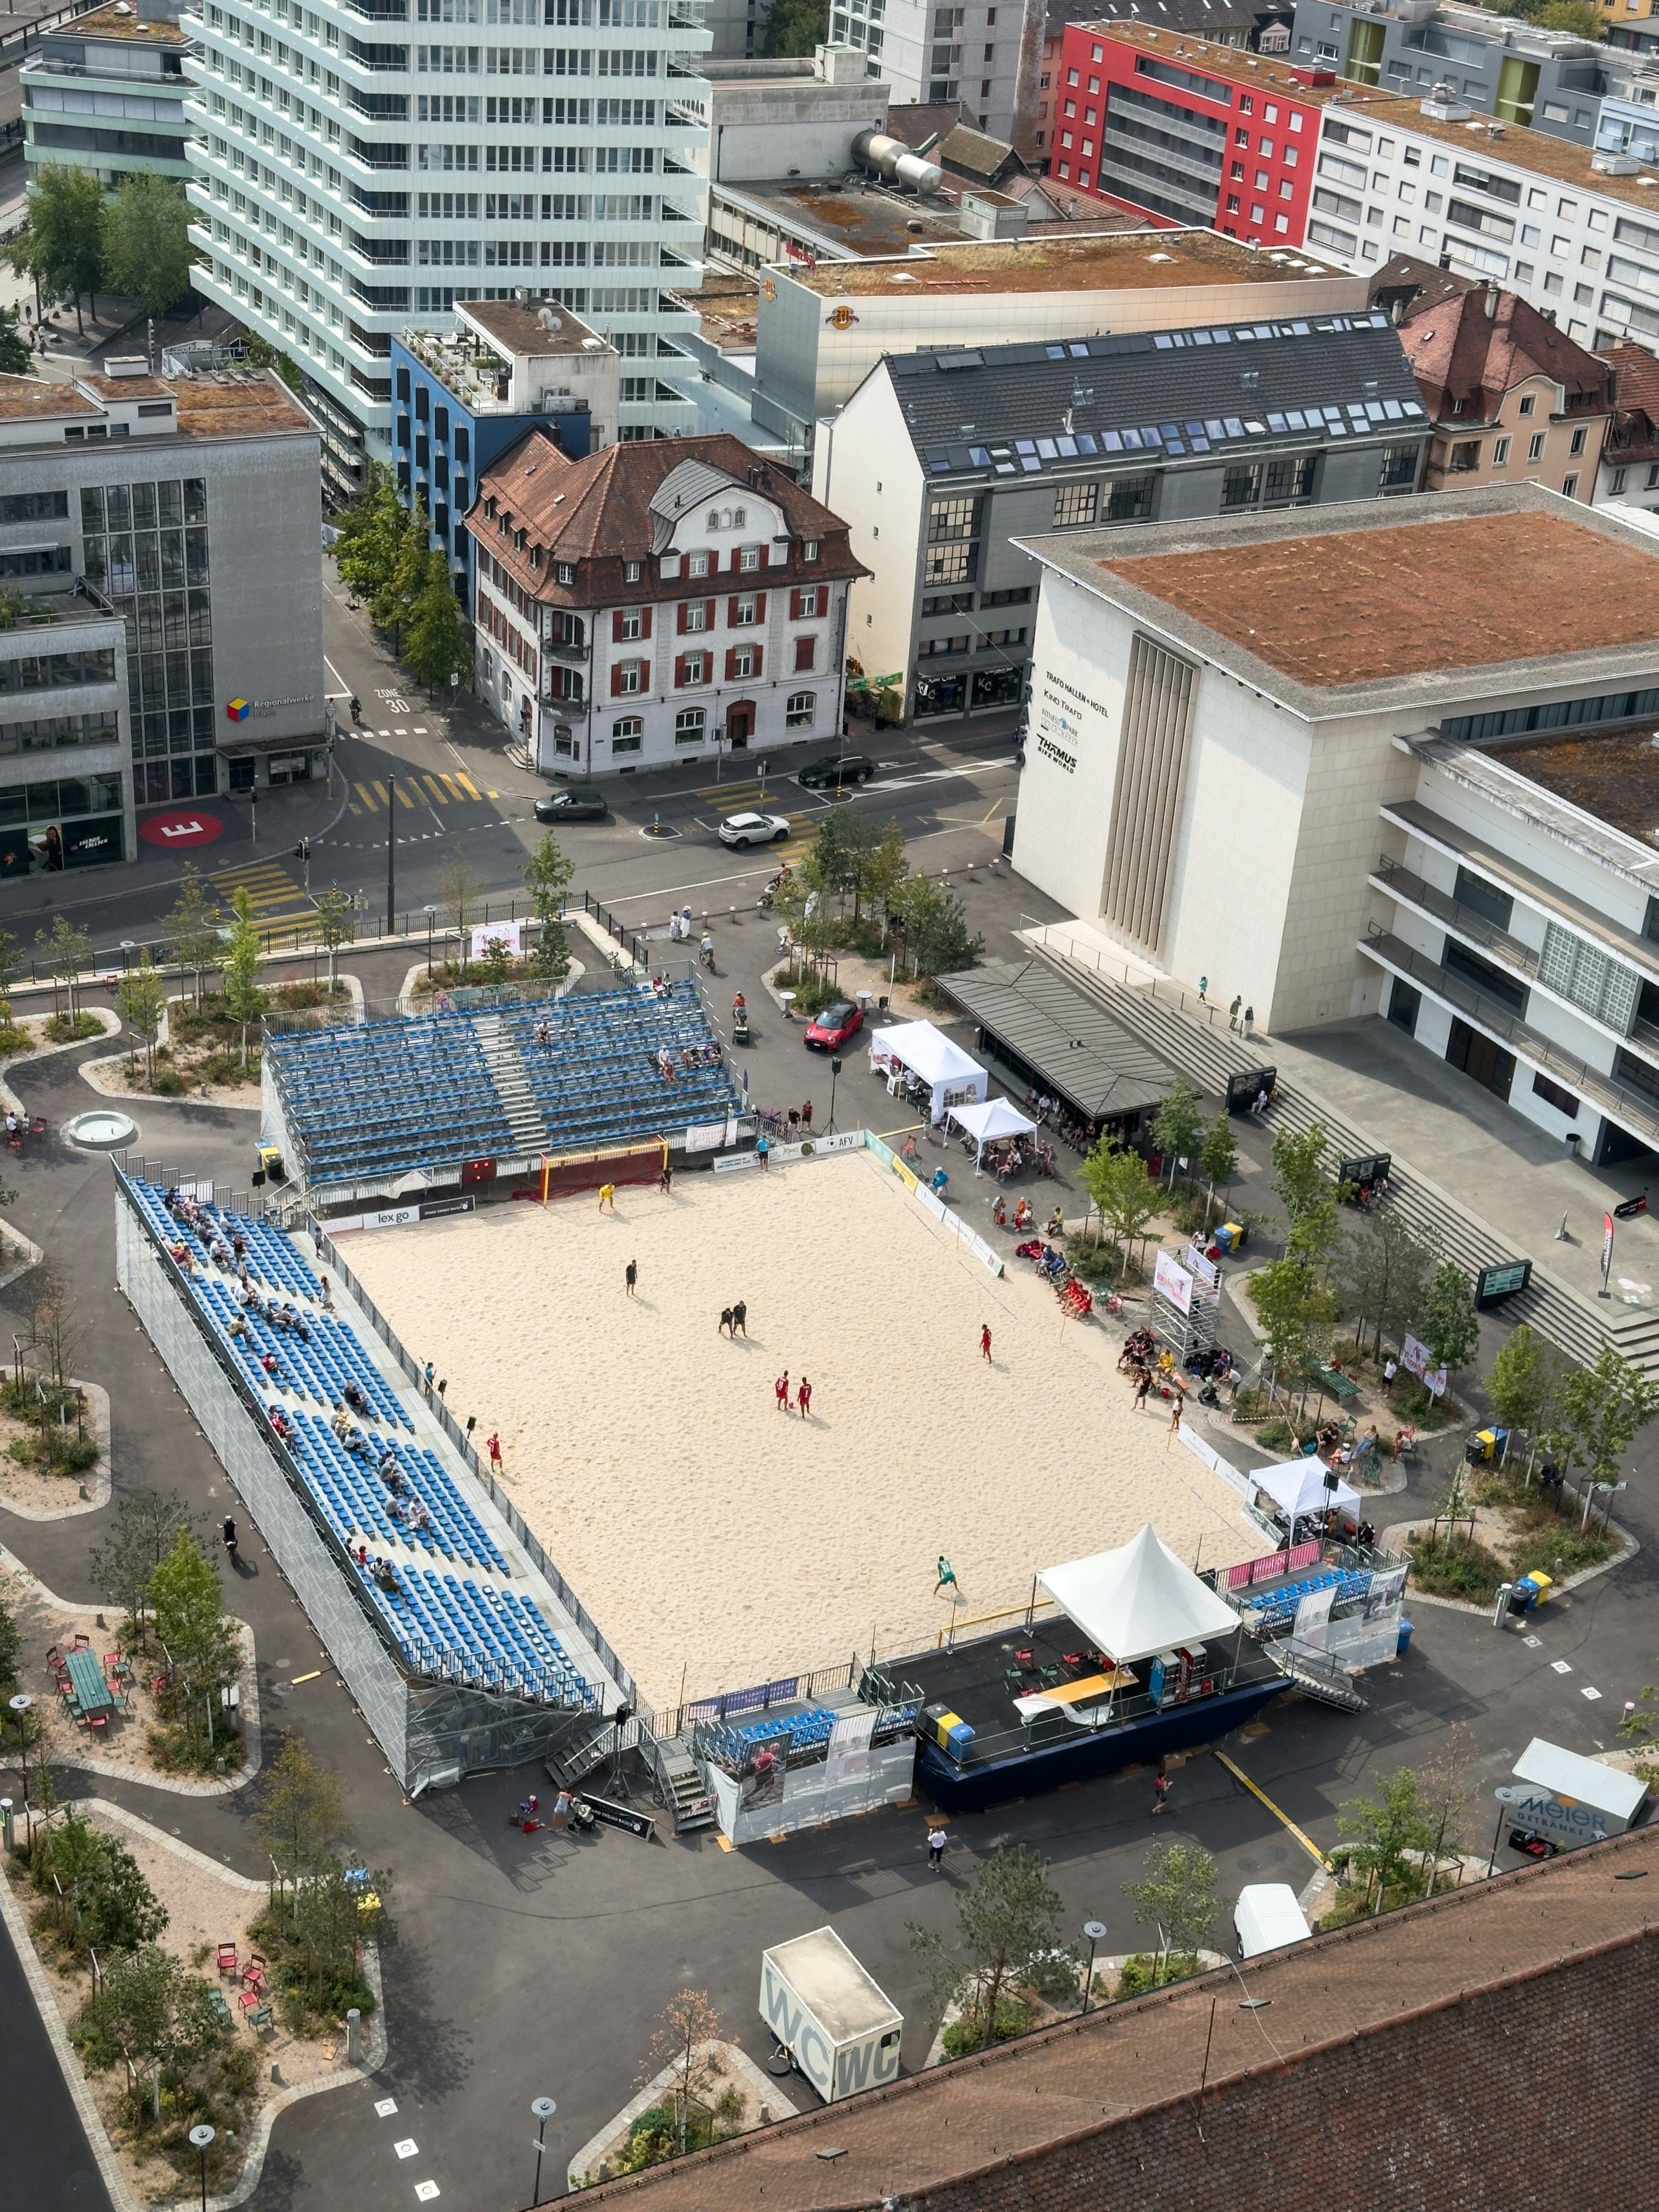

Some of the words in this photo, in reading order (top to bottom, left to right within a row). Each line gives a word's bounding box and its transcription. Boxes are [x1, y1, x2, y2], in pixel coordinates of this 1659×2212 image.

[255, 694, 314, 708] Regionalwerke
[374, 689, 402, 698] ZONE
[1047, 672, 1064, 688] TRAFO
[1065, 683, 1086, 703] HALLEN
[1091, 700, 1108, 718] HOTEL
[386, 699, 410, 713] 30
[1042, 708, 1060, 725] FITNESS
[1066, 724, 1079, 738] PARK
[1037, 746, 1052, 759] BIKE
[1053, 757, 1074, 774] WORLD
[839, 1136, 854, 1147] AFV
[378, 1213, 394, 1223] lex
[396, 1211, 409, 1223] go
[1517, 1812, 1584, 1836] GETRÄNKE
[765, 1967, 830, 2086] WC
[837, 2040, 898, 2096] WC
